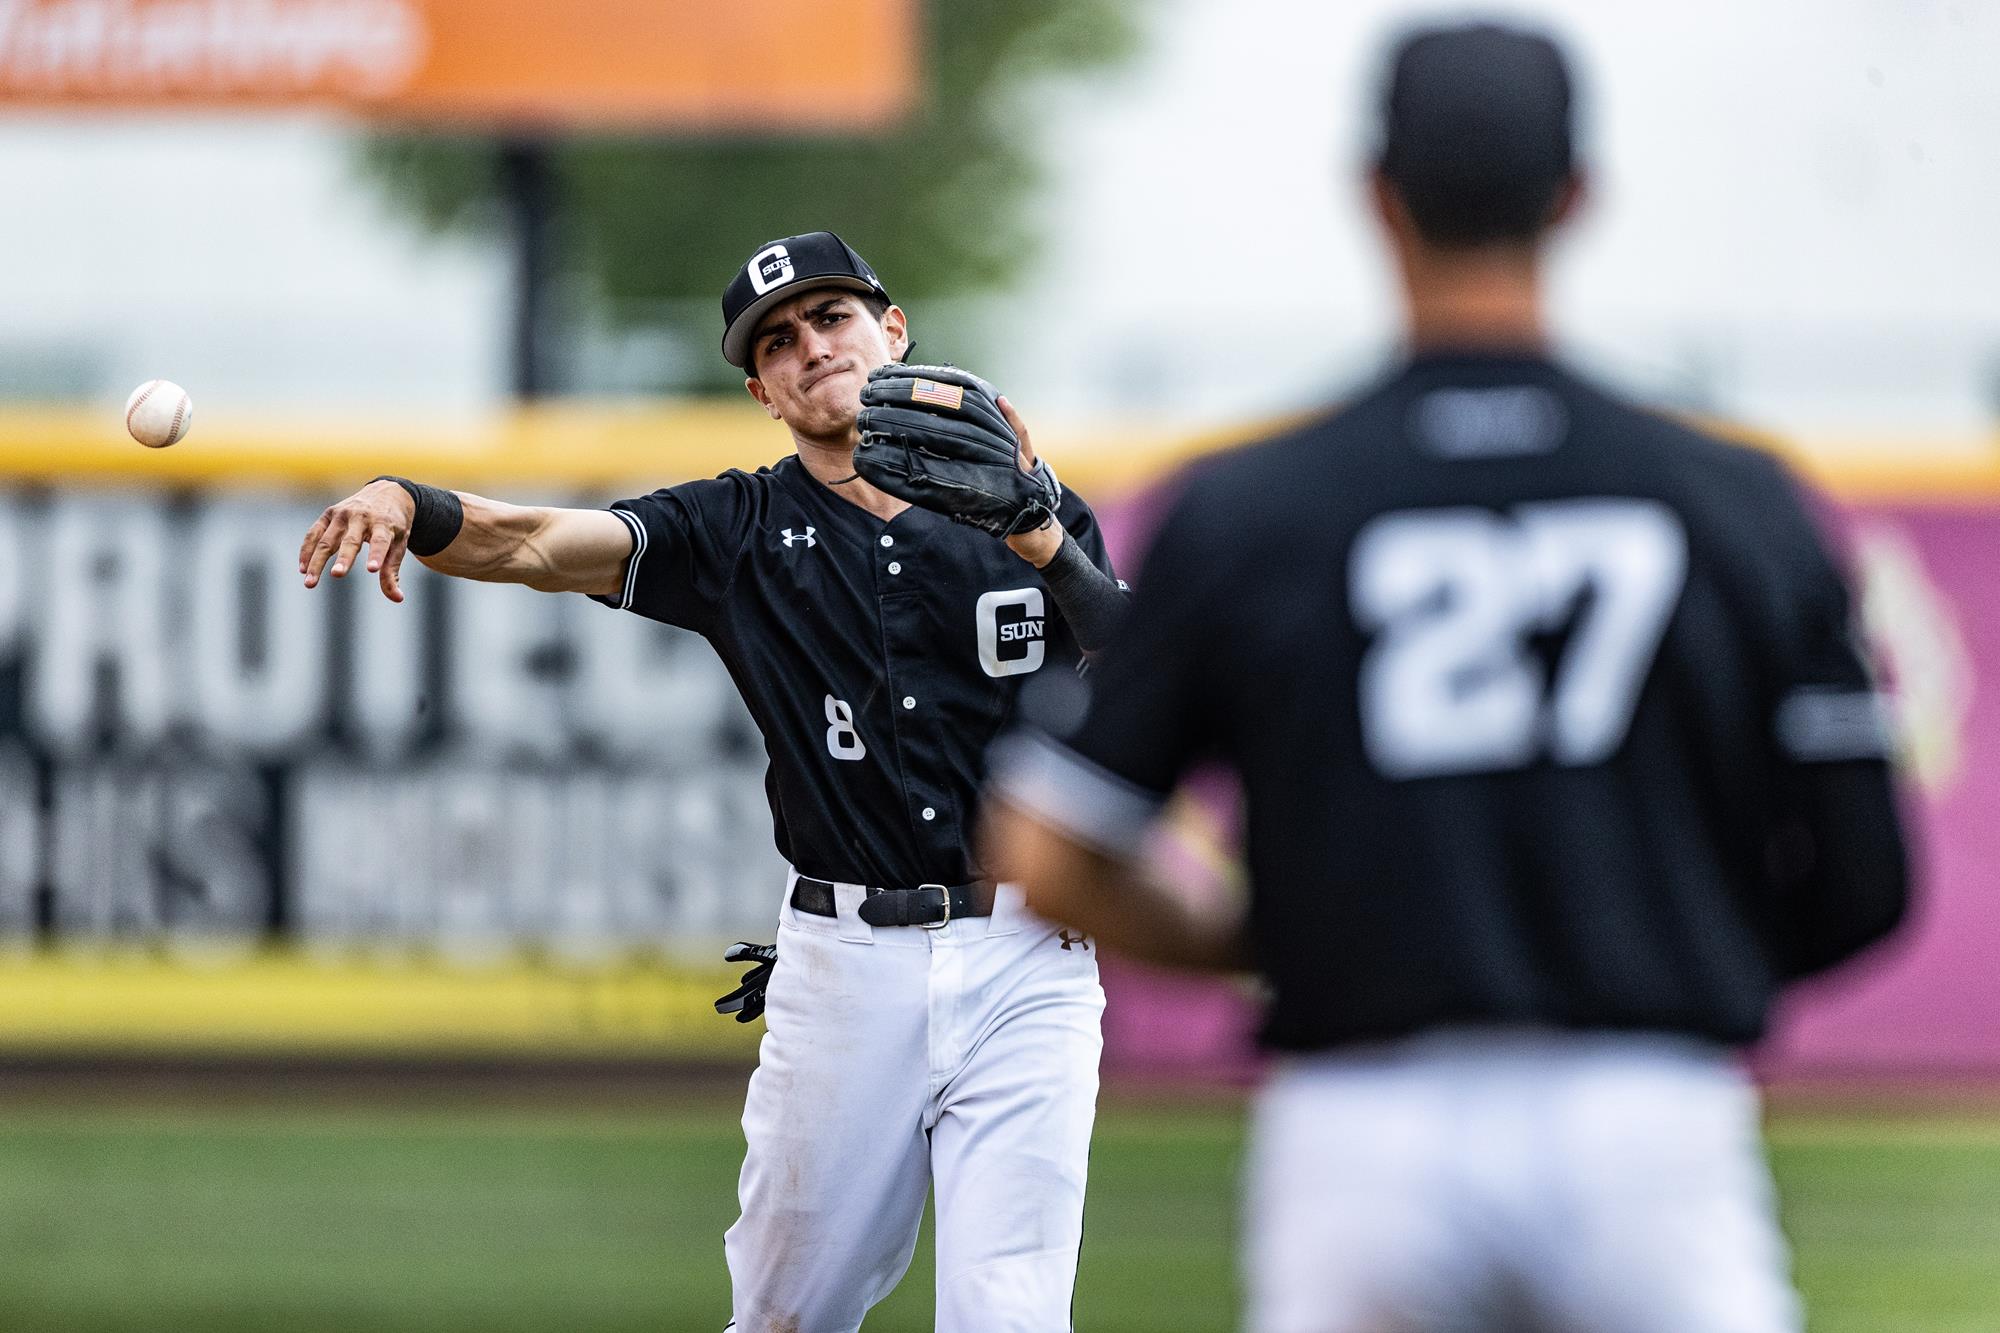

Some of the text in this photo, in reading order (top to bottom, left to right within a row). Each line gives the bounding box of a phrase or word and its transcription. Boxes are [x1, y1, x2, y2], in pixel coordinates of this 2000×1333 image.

[762, 257, 790, 276] SUN
[1001, 621, 1045, 641] SUN
[1350, 498, 1687, 780] 27
[825, 694, 866, 760] 8
